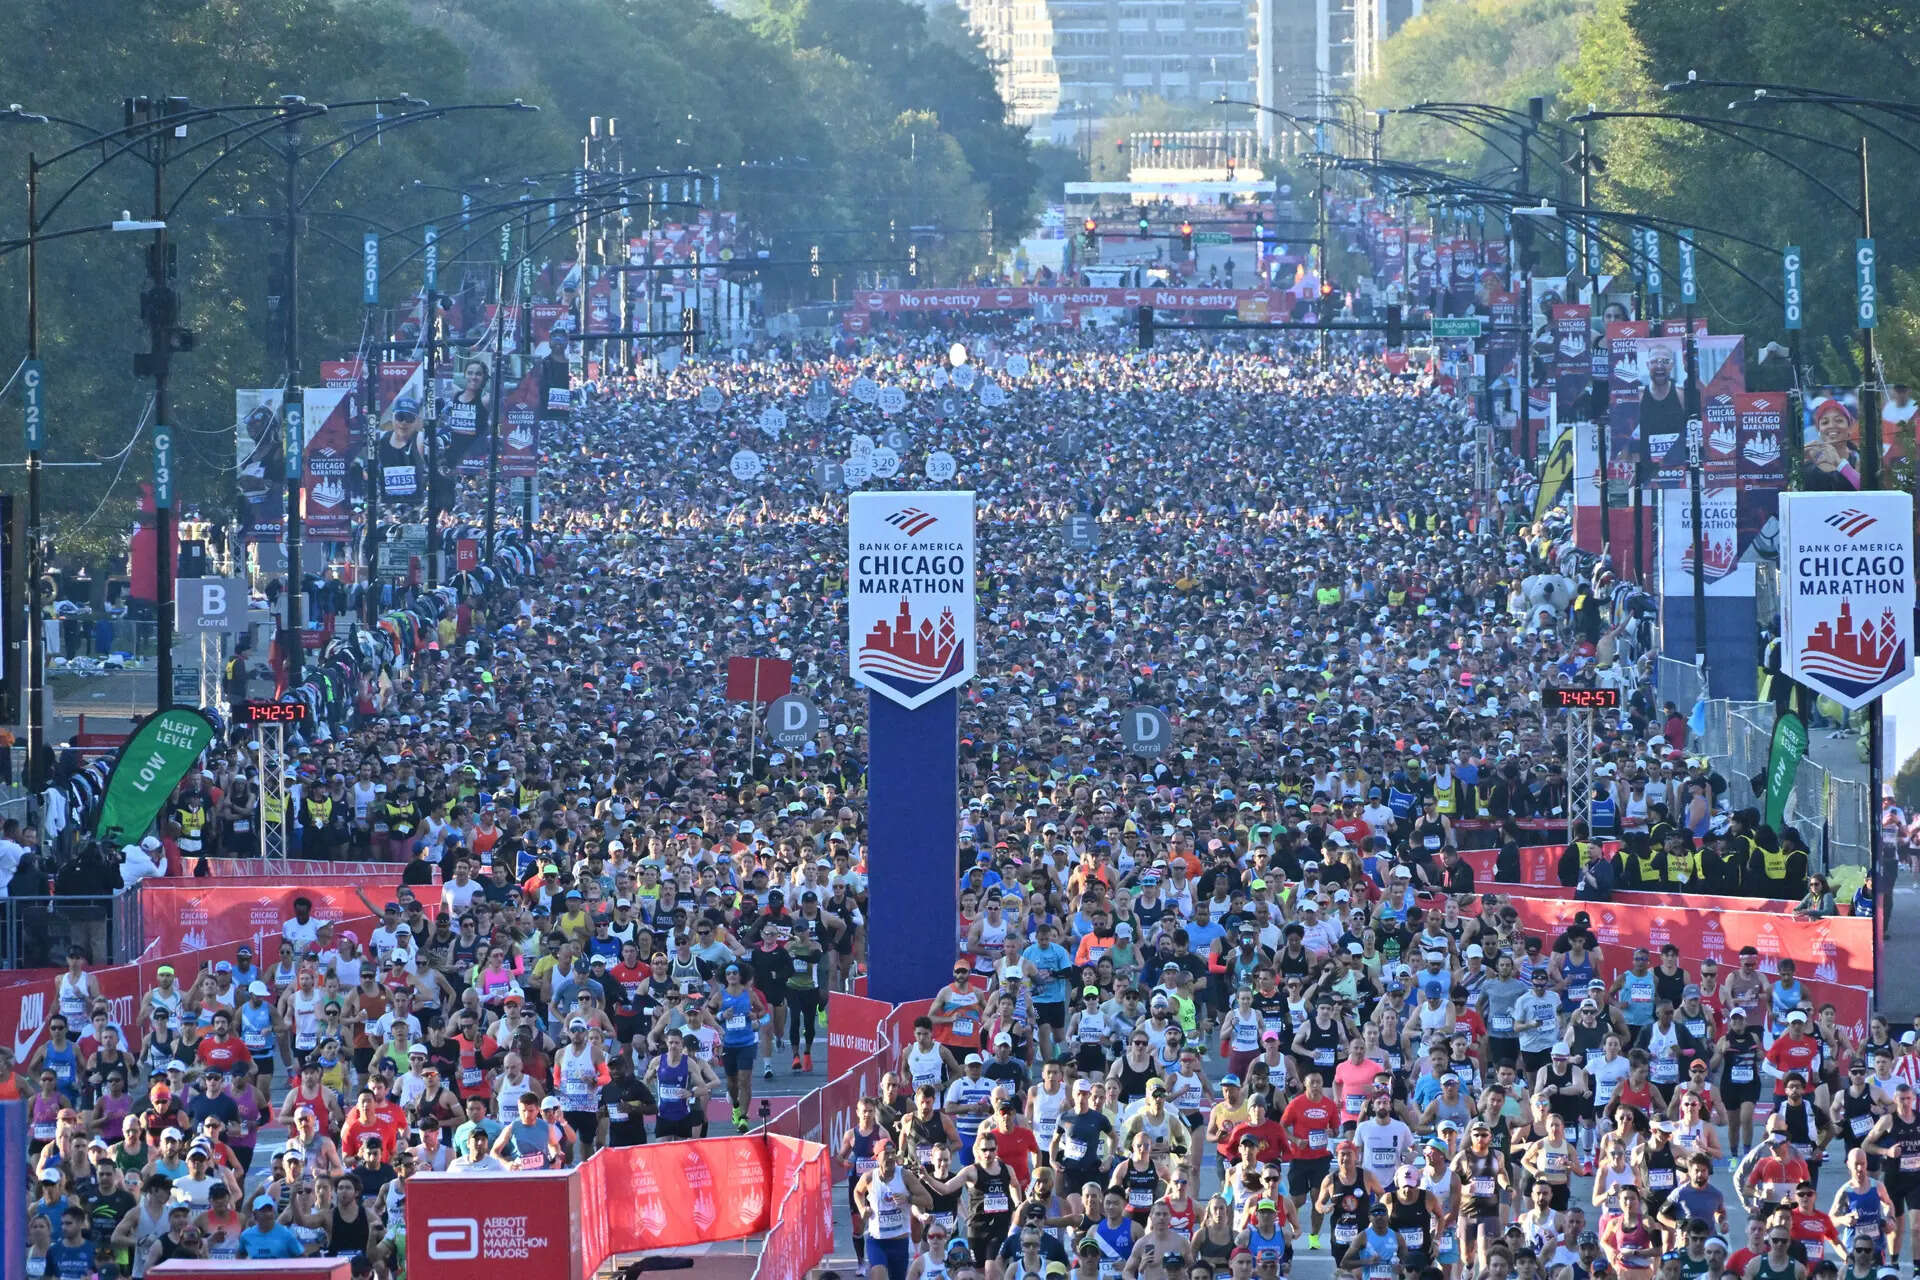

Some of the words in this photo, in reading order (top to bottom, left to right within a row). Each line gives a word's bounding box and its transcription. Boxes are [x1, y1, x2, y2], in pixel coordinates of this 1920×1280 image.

[425, 231, 437, 284] C221
[364, 240, 378, 296] C201
[1679, 236, 1695, 295] C140
[1784, 254, 1800, 321] C130
[1857, 247, 1874, 320] C120
[900, 294, 920, 306] No
[924, 294, 981, 308] re-entry
[1028, 291, 1048, 304] No
[1156, 292, 1177, 305] No
[1181, 293, 1238, 309] re-entry
[1044, 304, 1054, 318] K
[815, 382, 827, 395] H
[24, 369, 40, 441] C121
[943, 398, 955, 413] G
[1707, 408, 1736, 417] CHICAG
[1742, 415, 1780, 424] CHICAGO
[287, 410, 300, 471] C141
[888, 432, 902, 447] G
[155, 434, 170, 500] C131
[311, 462, 345, 470] CHICAGO
[734, 460, 756, 471] 3:35
[824, 465, 837, 481] F
[845, 467, 867, 478] 3:25
[929, 462, 952, 473] 3:30
[1072, 517, 1088, 539] E
[859, 543, 890, 551] BANK
[893, 543, 908, 551] OF
[911, 543, 963, 551] AMERICA
[1799, 544, 1830, 553] BANK
[1833, 544, 1849, 552] OF
[1851, 543, 1904, 551] AMERICA
[460, 550, 468, 560] EE
[858, 555, 965, 575] CHICAGO
[1799, 555, 1905, 577] CHICAGO
[859, 578, 964, 594] MARATHON
[1799, 578, 1905, 596] MARATHON
[202, 584, 226, 615] B
[197, 617, 228, 627] Corral
[783, 700, 808, 731] D
[160, 718, 198, 738] ALERT
[1135, 712, 1160, 741] D
[156, 730, 193, 750] LEVEL
[778, 732, 808, 742] Corral
[1132, 742, 1161, 753] Corral
[1781, 735, 1797, 759] LEVEL
[132, 751, 167, 793] LOW
[1772, 756, 1786, 797] LOW
[180, 912, 208, 920] CHICAGO
[250, 911, 278, 919] CHICAGO
[313, 911, 343, 919] CHICAGO
[1649, 931, 1670, 940] CHICAGO
[1702, 935, 1724, 944] CHICAGO
[19, 991, 45, 1031] RUN
[108, 995, 133, 1026] BOTT
[1533, 1003, 1552, 1011] Team
[829, 1032, 845, 1048] BANK
[846, 1034, 855, 1049] OF
[854, 1035, 878, 1053] AMERICA
[988, 1185, 1004, 1194] CAL
[483, 1216, 528, 1228] ABBOTT
[483, 1228, 526, 1238] WORLD
[483, 1238, 548, 1249] MARATHON
[483, 1249, 529, 1260] MAJORS
